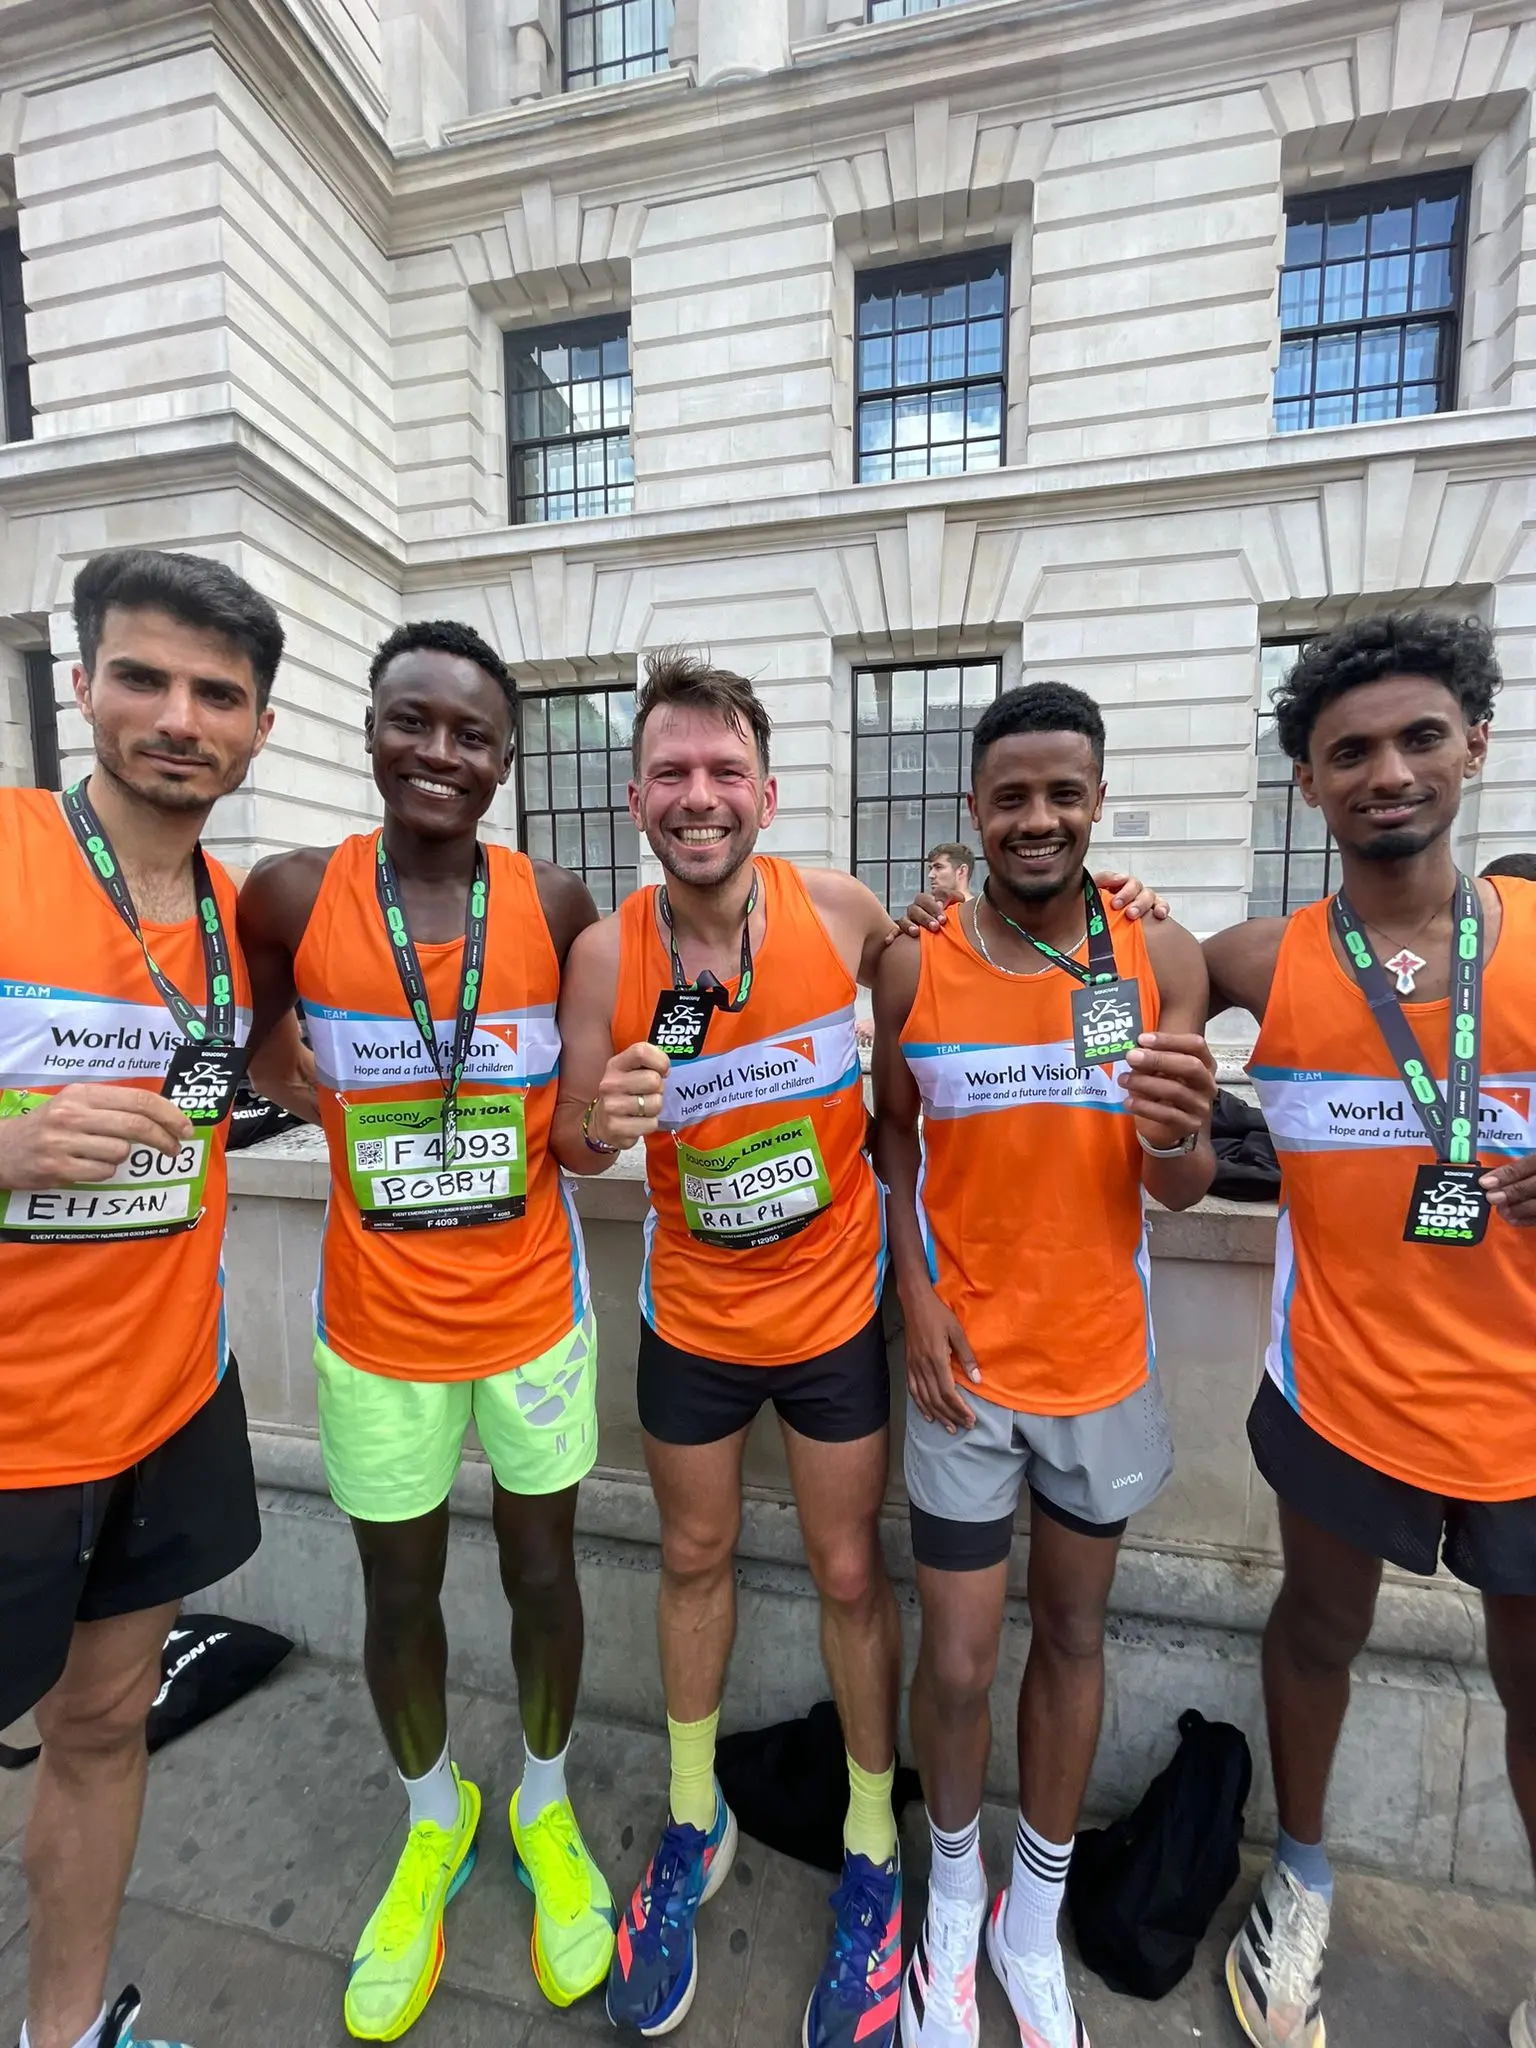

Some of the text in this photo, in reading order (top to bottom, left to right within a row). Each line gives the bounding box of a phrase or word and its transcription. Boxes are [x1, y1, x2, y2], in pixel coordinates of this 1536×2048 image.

[4, 985, 51, 998] TEAM
[322, 1009, 348, 1019] TEAM
[657, 1024, 701, 1035] LDN
[1082, 1016, 1133, 1036] LDN
[51, 1027, 188, 1051] World Vis
[656, 1035, 694, 1045] 10K
[1084, 1029, 1129, 1047] 10K
[352, 1040, 421, 1059] World
[936, 1044, 961, 1055] TEAM
[1084, 1040, 1135, 1058] 2024
[44, 1055, 84, 1069] Hope
[88, 1057, 115, 1068] and
[118, 1060, 125, 1068] a
[127, 1057, 161, 1070] future
[354, 1065, 380, 1076] Hope
[382, 1066, 401, 1075] and
[404, 1067, 411, 1075] a
[476, 1063, 514, 1073] children
[675, 1061, 796, 1101] World Vision
[965, 1063, 1091, 1087] World Vision
[1293, 1072, 1323, 1081] TEAM
[171, 1084, 229, 1097] LDN
[681, 1102, 703, 1116] Hope
[704, 1098, 720, 1109] and
[728, 1091, 754, 1103] future
[755, 1087, 768, 1097] for
[769, 1083, 780, 1093] all
[781, 1075, 815, 1090] children
[968, 1092, 991, 1101] Hope
[993, 1090, 1010, 1099] and
[1019, 1087, 1047, 1098] future
[1048, 1086, 1061, 1096] for
[1061, 1087, 1073, 1096] all
[1074, 1086, 1107, 1097] children
[181, 1108, 220, 1119] 024
[359, 1105, 511, 1125] saucony DN 10K
[1327, 1101, 1404, 1121] World
[1329, 1125, 1523, 1140] Hope and a future hildren
[395, 1132, 511, 1165] F 4093
[685, 1129, 803, 1168] saucony LDN 10K
[381, 1169, 495, 1205] BOBBY
[706, 1156, 813, 1202] F 12950
[27, 1191, 168, 1221] EHSAN
[702, 1202, 785, 1227] RALPH
[1419, 1202, 1480, 1218] LDN
[435, 1217, 459, 1227] 4093
[1418, 1214, 1470, 1229] 10K
[751, 1233, 780, 1247] F 12950
[1414, 1226, 1474, 1239] 2024
[167, 1632, 232, 1678] LDN 10
